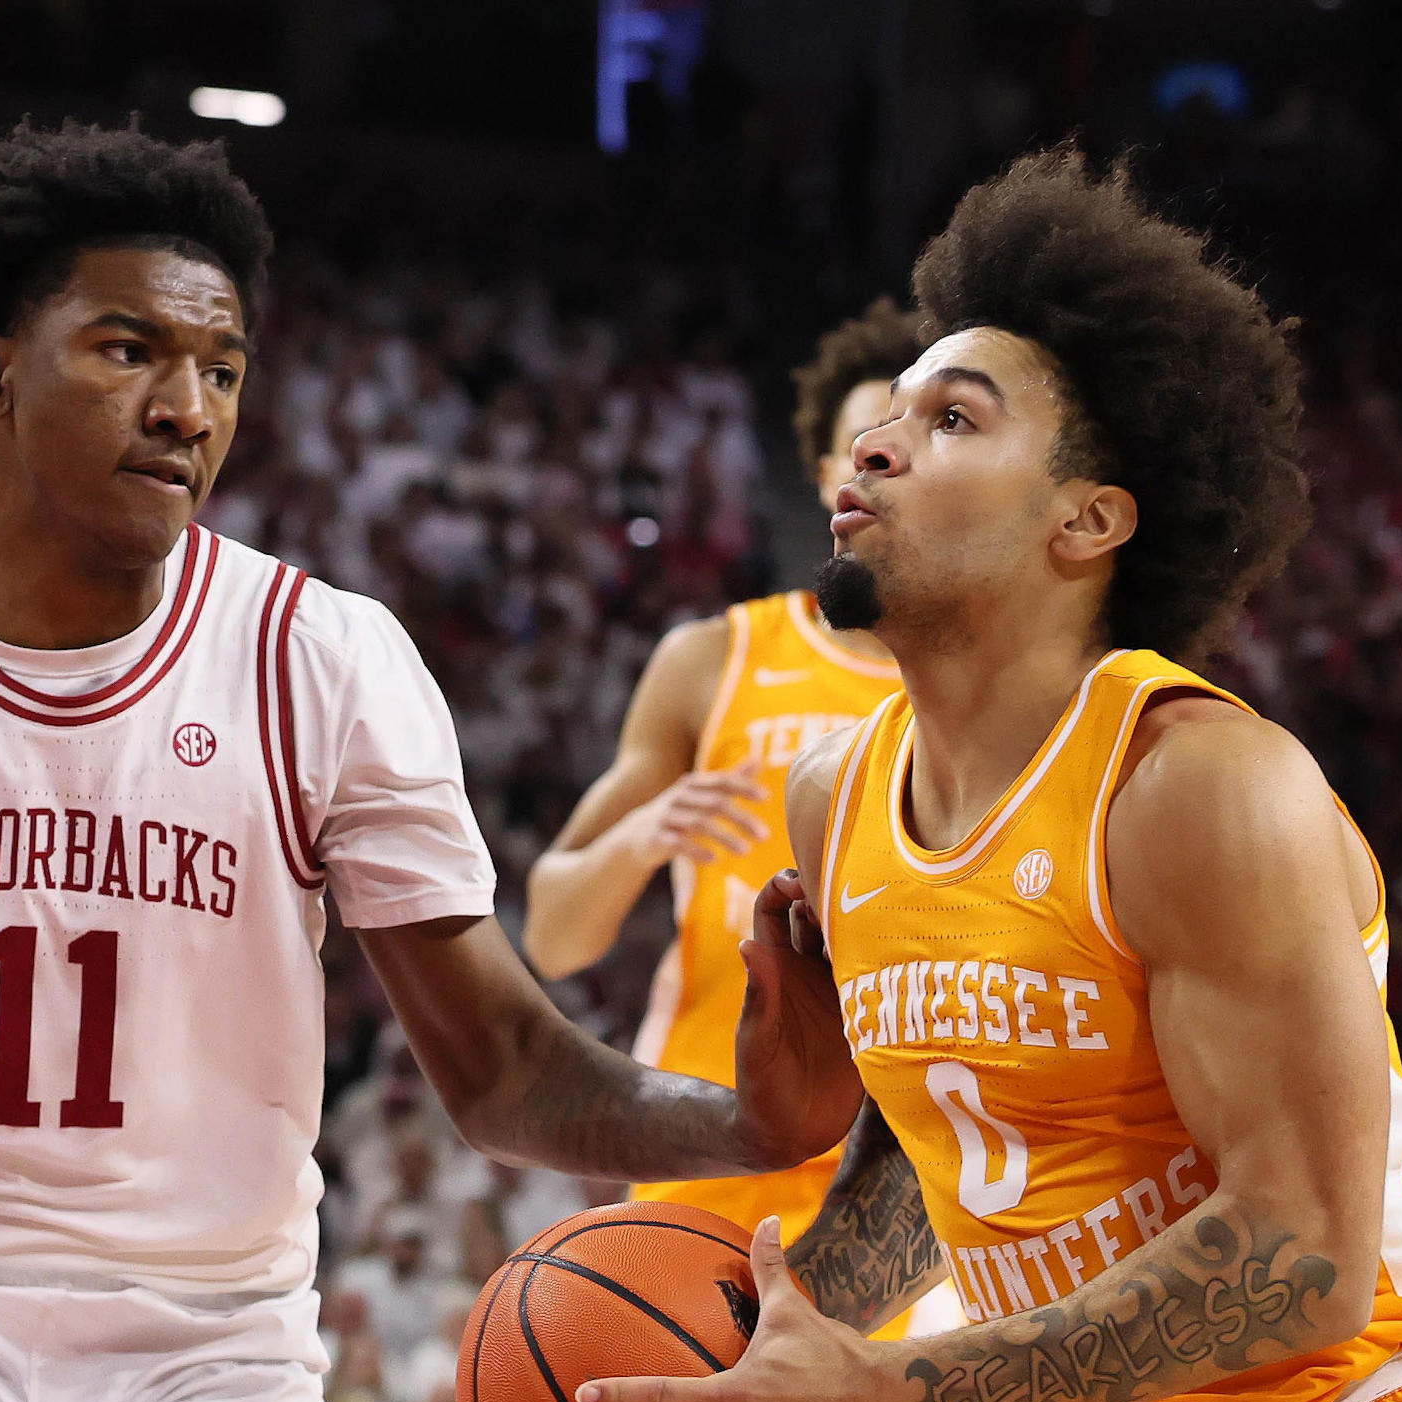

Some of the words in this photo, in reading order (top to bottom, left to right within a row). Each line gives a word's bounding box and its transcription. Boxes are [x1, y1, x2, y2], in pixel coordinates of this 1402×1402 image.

[174, 724, 215, 765] SEC
[1014, 850, 1052, 897] SEC
[840, 960, 1109, 1060] TENNESSEE
[924, 1061, 1028, 1218] 0
